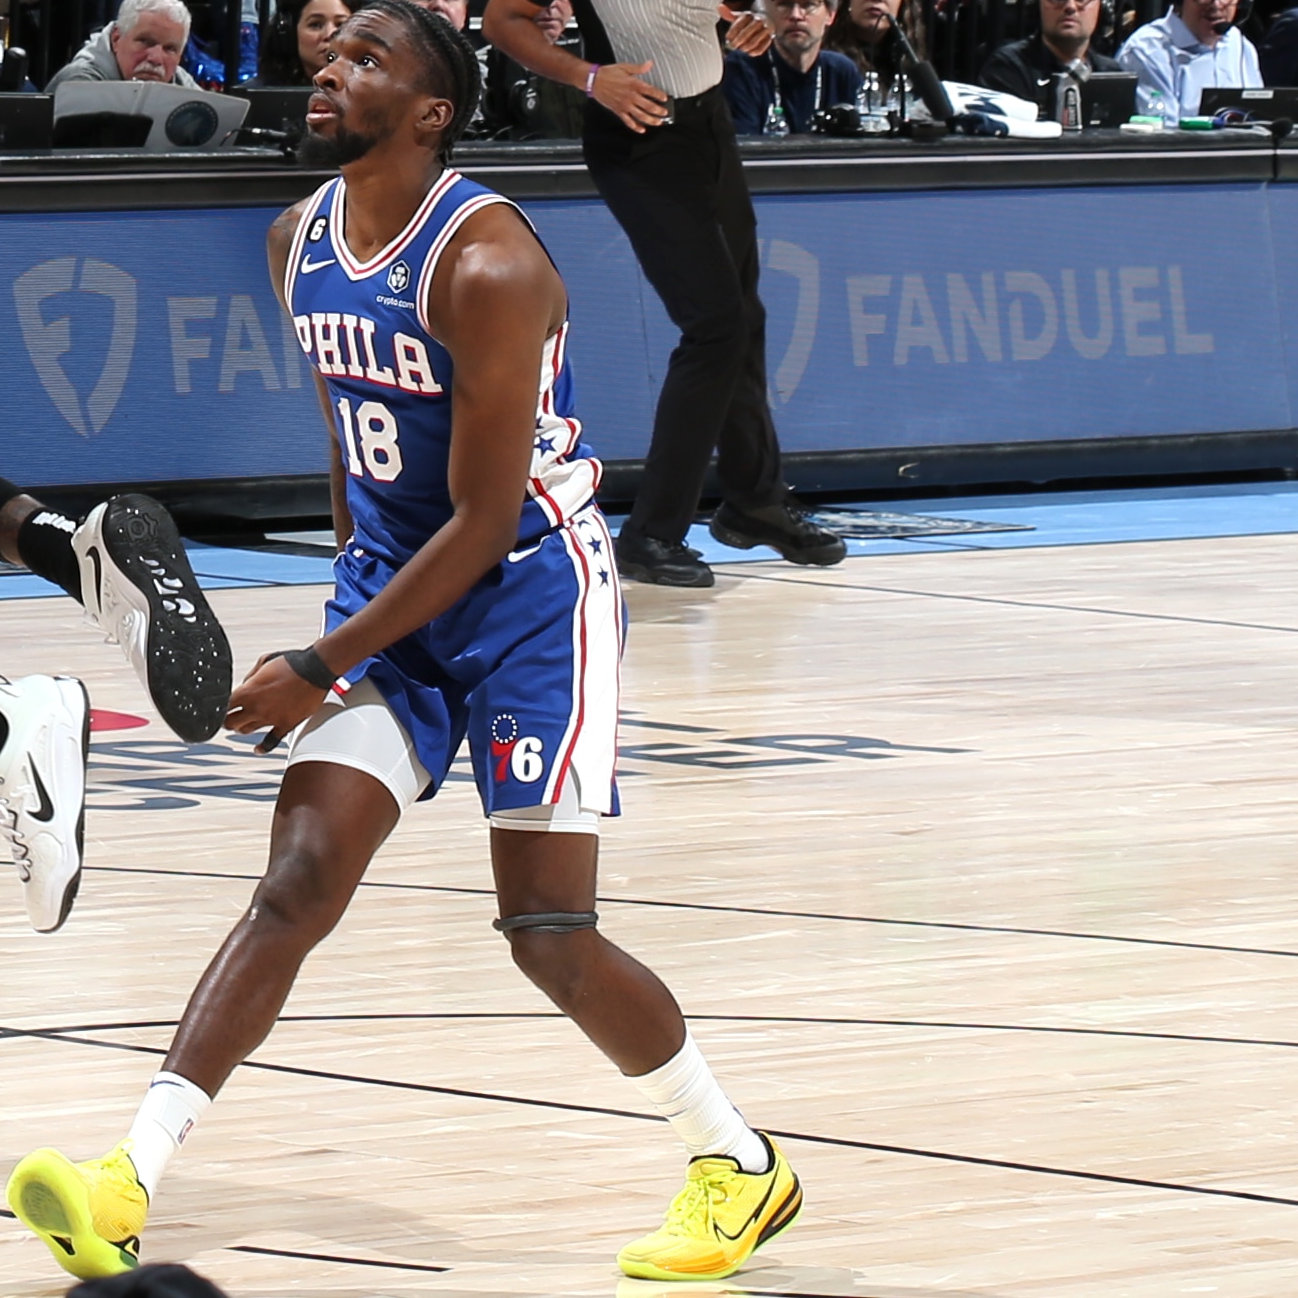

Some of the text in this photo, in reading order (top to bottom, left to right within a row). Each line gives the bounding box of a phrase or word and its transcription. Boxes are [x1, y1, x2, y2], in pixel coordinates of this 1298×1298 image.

[311, 219, 325, 240] 6
[376, 294, 415, 310] crypto.com
[846, 264, 1214, 367] FANDUEL
[294, 313, 444, 396] PHILA
[337, 397, 403, 482] 18
[491, 736, 543, 783] 76
